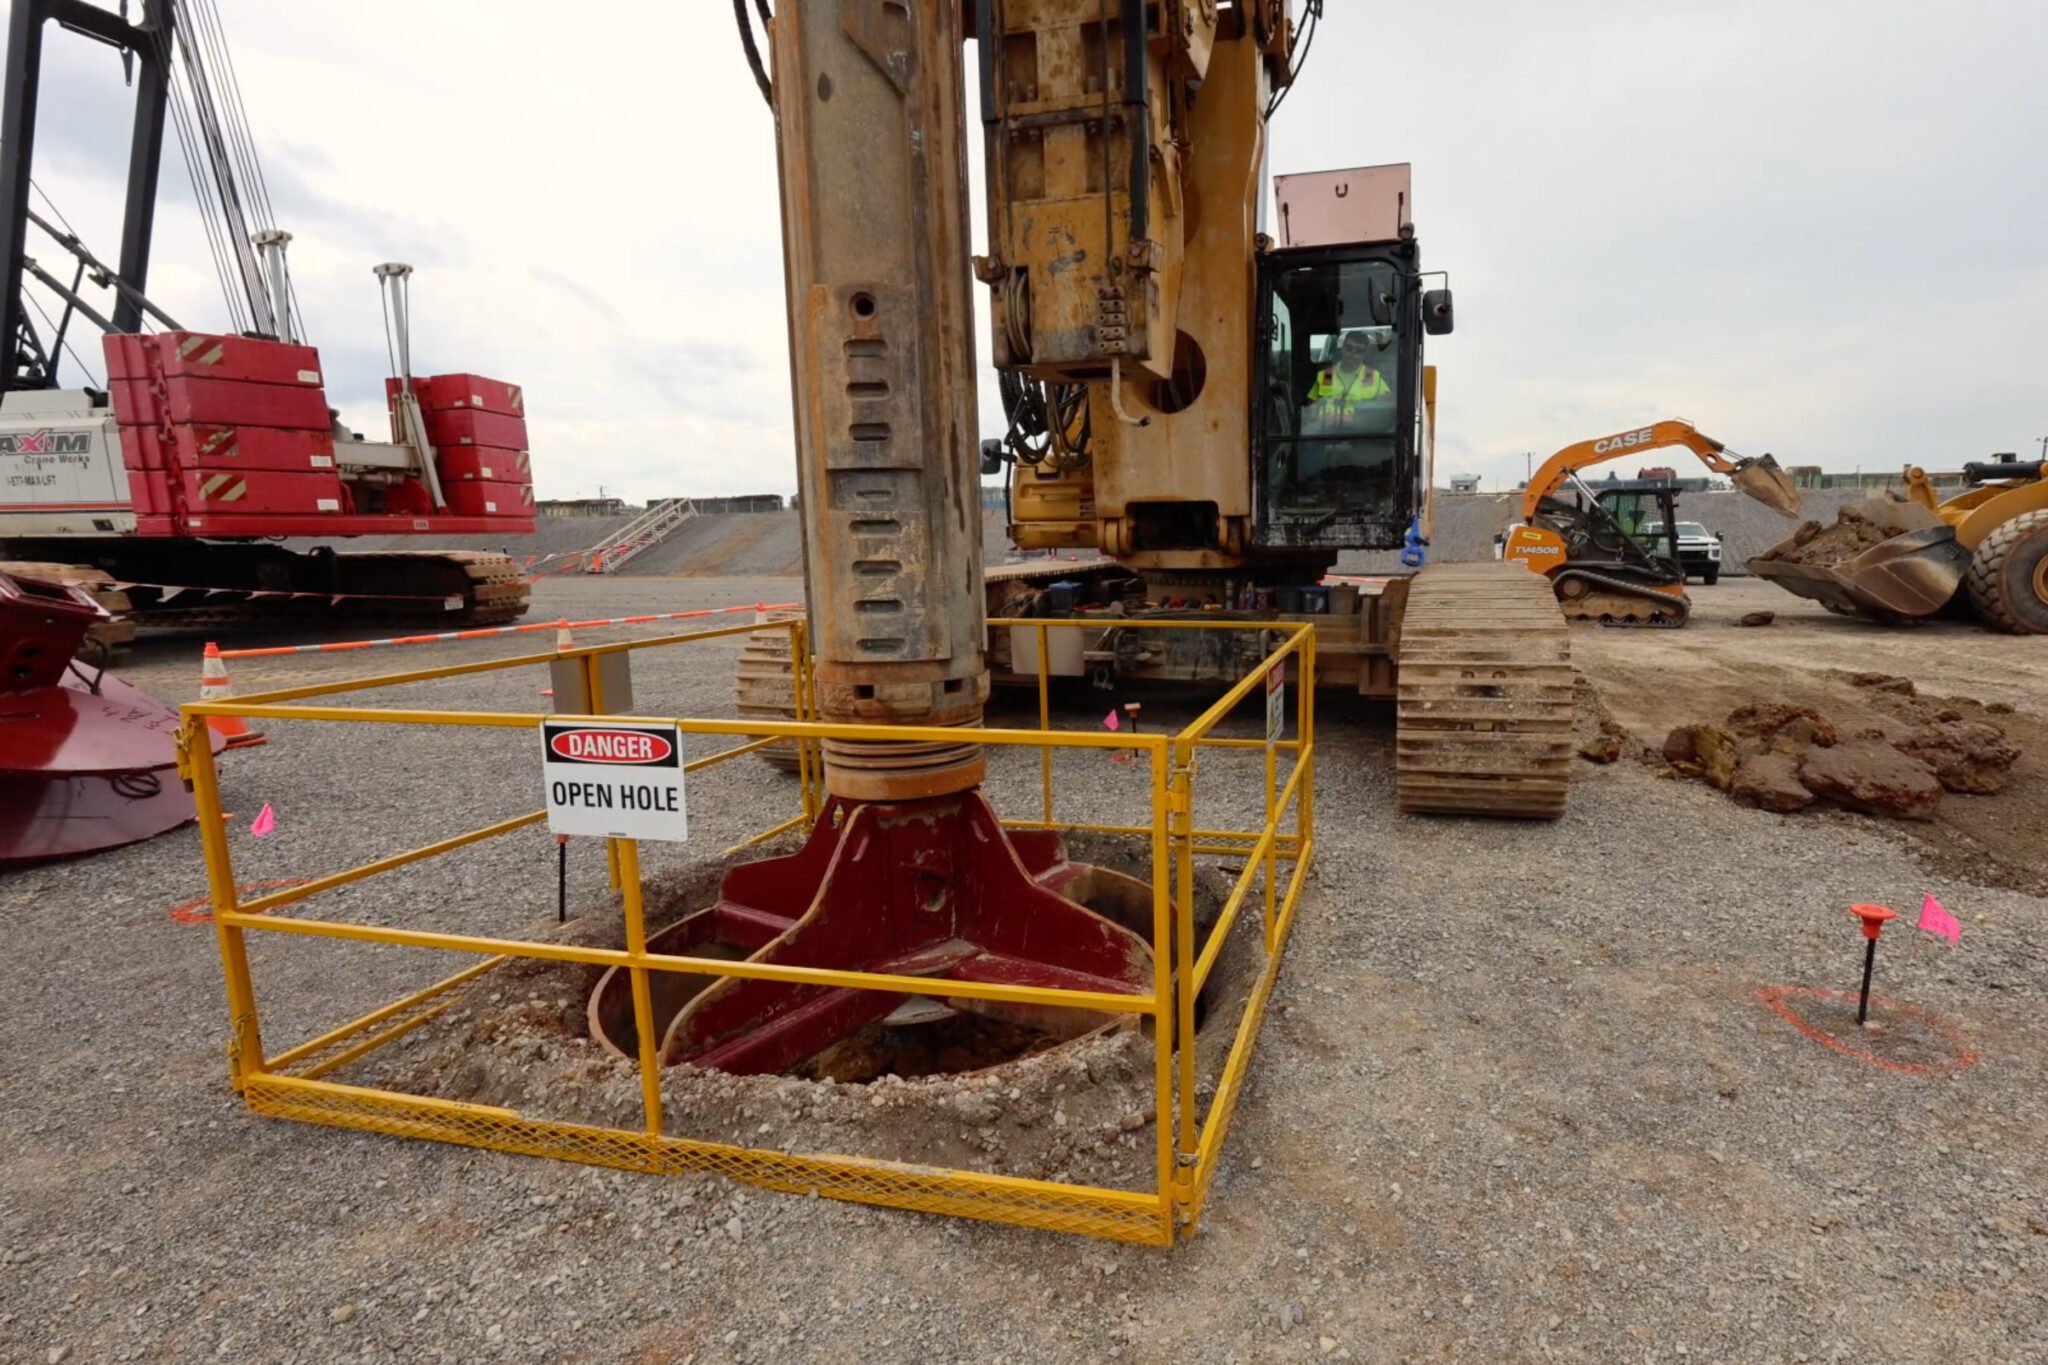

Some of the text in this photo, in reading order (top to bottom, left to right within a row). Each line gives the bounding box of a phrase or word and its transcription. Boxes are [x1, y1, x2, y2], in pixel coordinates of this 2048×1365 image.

[1593, 428, 1653, 453] CASE
[24, 454, 91, 464] Crane Works
[568, 734, 652, 758] DANGER
[552, 781, 679, 812] OPEN HOLE
